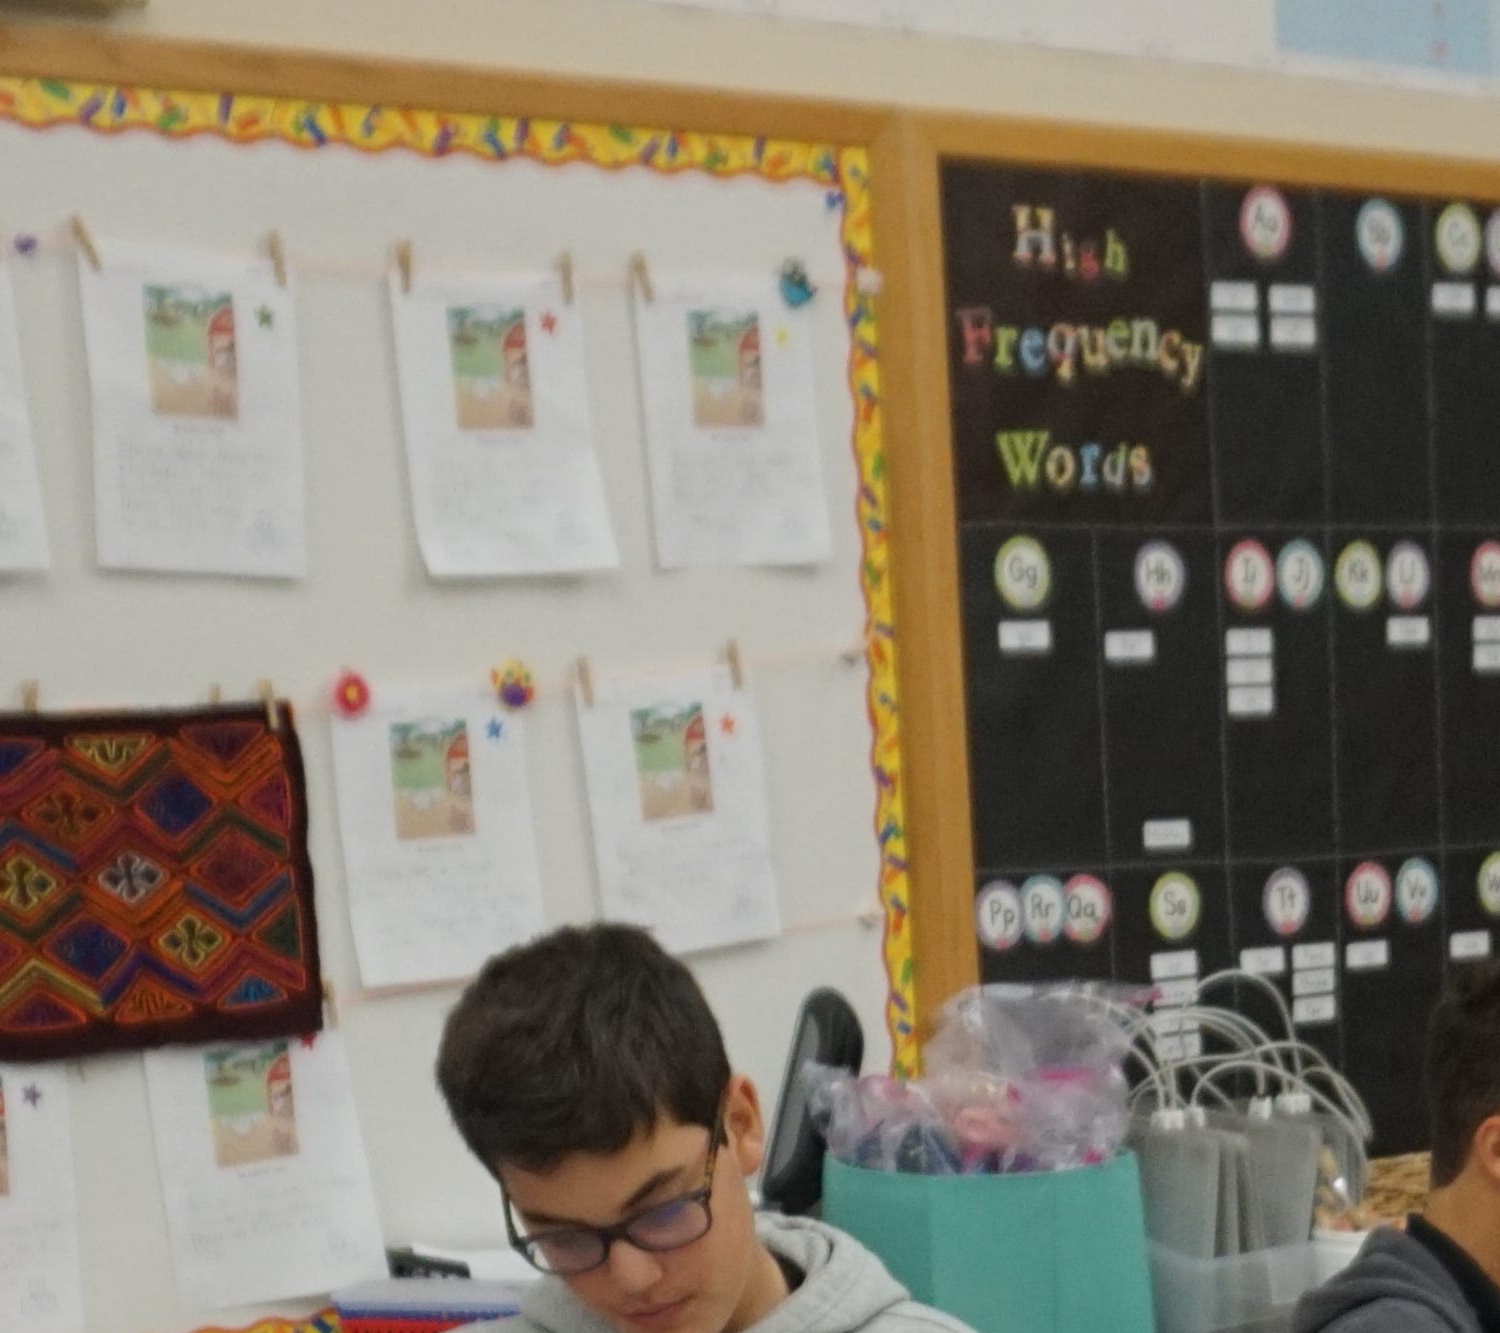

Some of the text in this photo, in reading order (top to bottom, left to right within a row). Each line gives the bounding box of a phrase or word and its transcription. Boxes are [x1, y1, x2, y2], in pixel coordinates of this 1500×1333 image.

[1012, 204, 1129, 278] High
[958, 307, 1202, 390] Frequency
[997, 430, 1153, 487] Words
